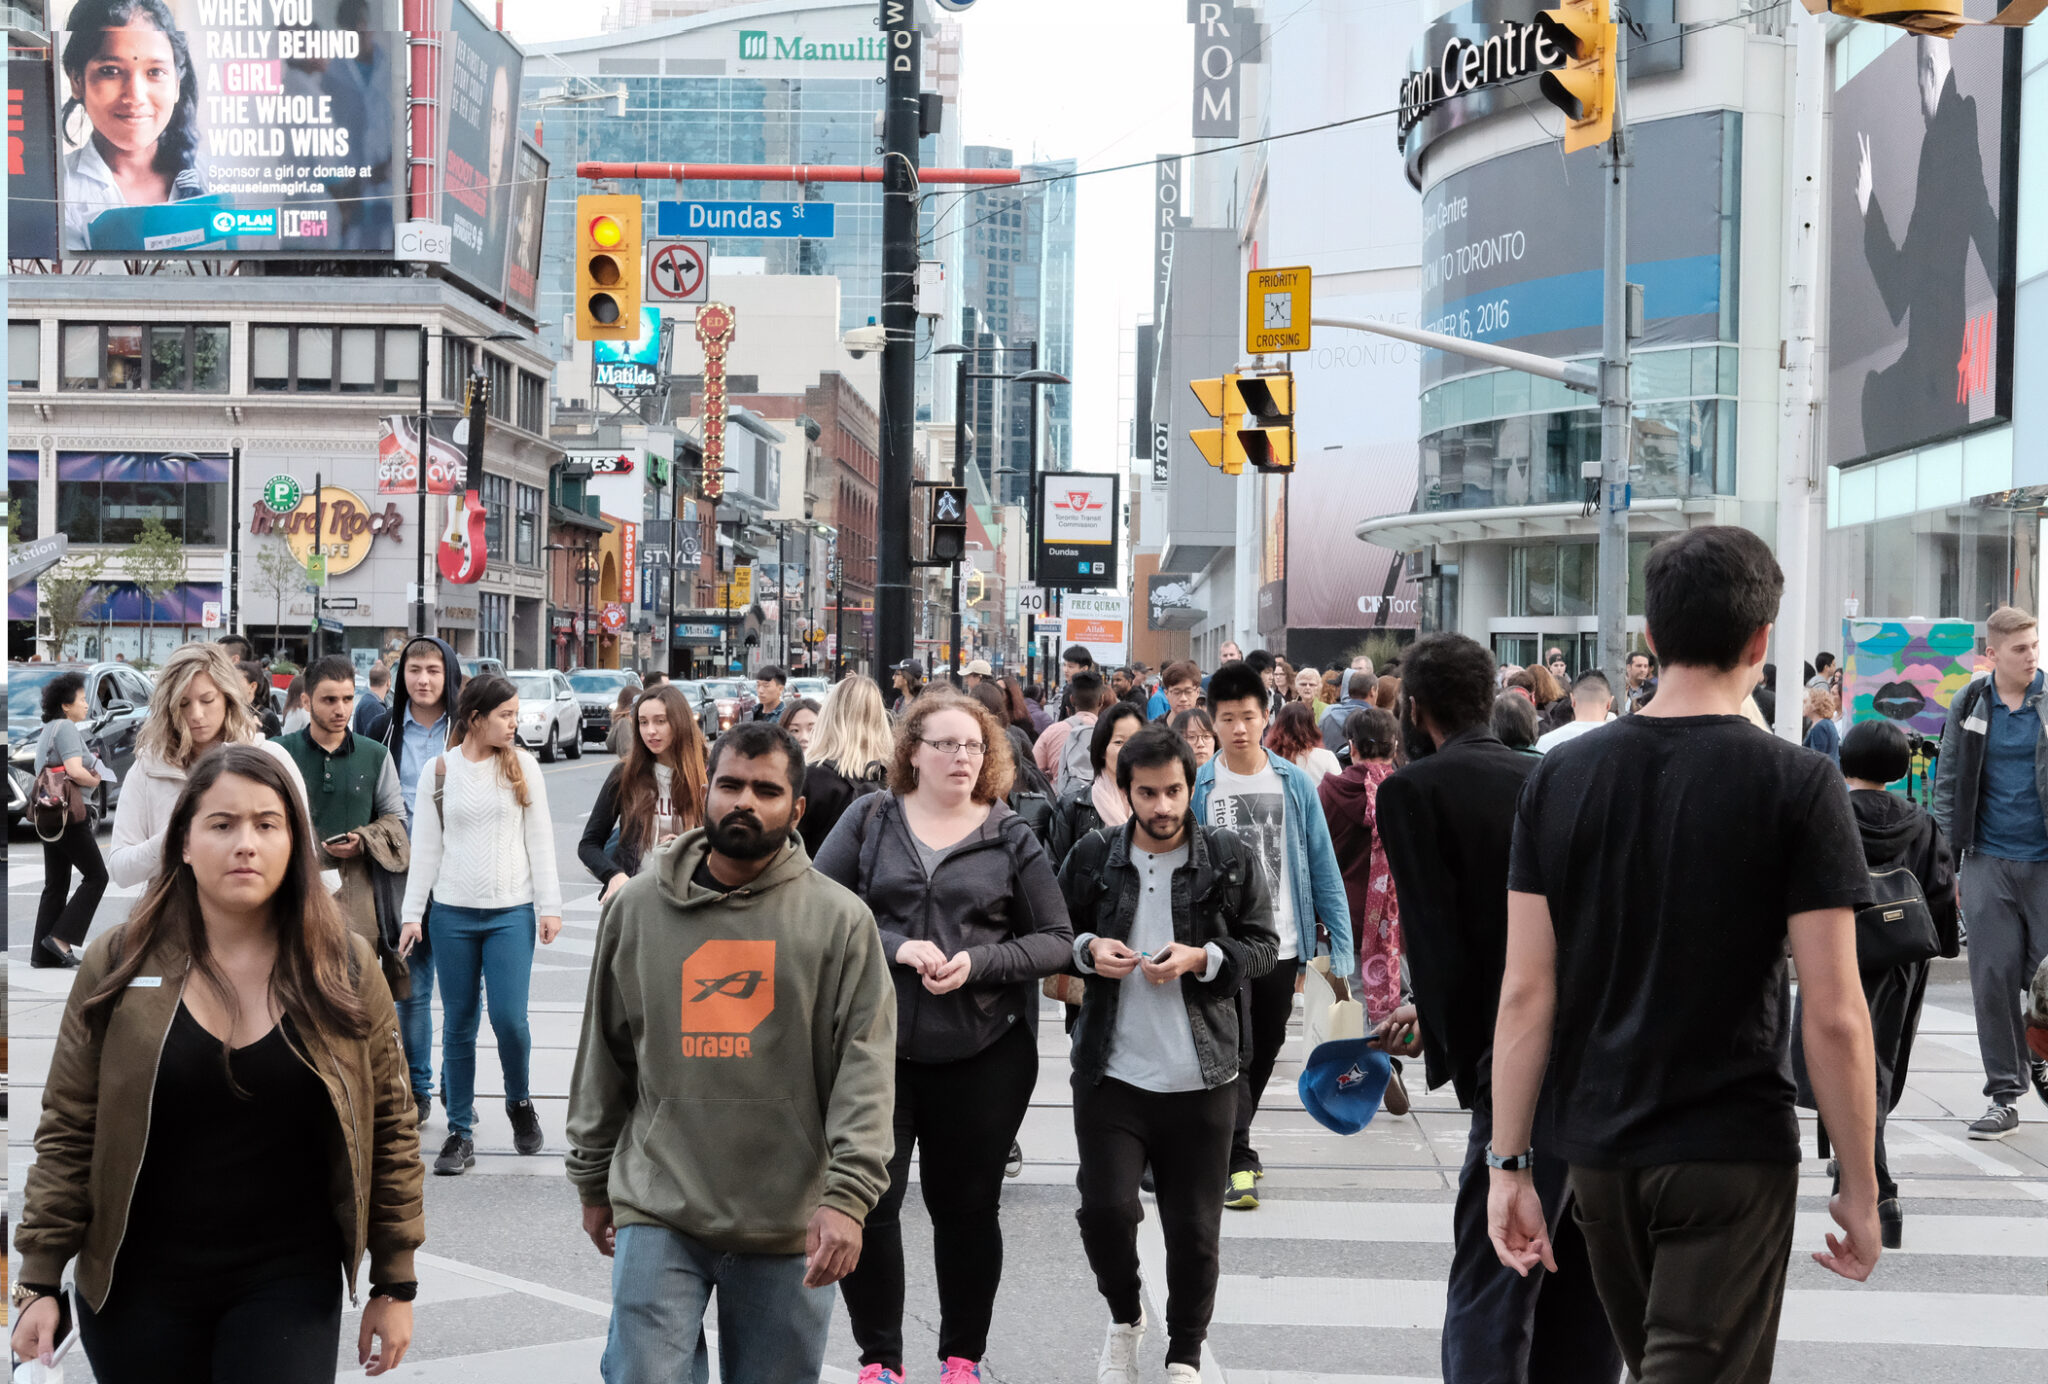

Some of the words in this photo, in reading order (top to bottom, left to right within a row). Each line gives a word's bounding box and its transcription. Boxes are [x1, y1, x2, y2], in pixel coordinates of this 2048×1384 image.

[198, 0, 262, 27] WHEN
[269, 0, 313, 27] YOU
[206, 31, 272, 59] RALLY
[278, 31, 360, 59] BEHIND
[774, 36, 887, 61] Manulif
[1441, 19, 1559, 97] Centre
[207, 63, 221, 91] A
[227, 63, 285, 95] GIRL,
[207, 96, 249, 124] THE
[256, 96, 333, 124] WHOLE
[208, 128, 285, 157] WORLD
[291, 128, 349, 157] WINS
[208, 164, 260, 178] Sponsor
[265, 167, 272, 177] a
[275, 164, 294, 179] girl
[297, 167, 310, 177] or
[313, 164, 356, 177] donate
[359, 165, 372, 177] at
[208, 181, 324, 194] becauseiamagirl.ca
[237, 214, 273, 226] PLAN
[689, 204, 782, 228] Dundas
[792, 206, 805, 218] St
[1437, 197, 1468, 230] Centre
[1441, 252, 1453, 281] TO
[1456, 230, 1526, 276] TORONTO
[1259, 273, 1298, 288] PRIORITY
[706, 318, 724, 327] ED
[1477, 299, 1510, 334] 2016
[1257, 333, 1300, 348] CROSSING
[1957, 310, 1993, 406] H&M
[596, 364, 656, 385] Matilda
[274, 483, 290, 502] P
[250, 499, 327, 536] Hard
[329, 499, 404, 544] Rock
[1055, 513, 1079, 521] Toronto
[1058, 521, 1098, 529] Commission
[307, 543, 349, 558] CAFE
[643, 550, 701, 565] STYLE
[1048, 548, 1080, 557] Dundas
[1020, 594, 1042, 610] 40
[1071, 599, 1092, 610] FREE
[1094, 600, 1121, 612] QURAN
[1357, 595, 1384, 613] CF
[681, 1035, 750, 1058] orage
